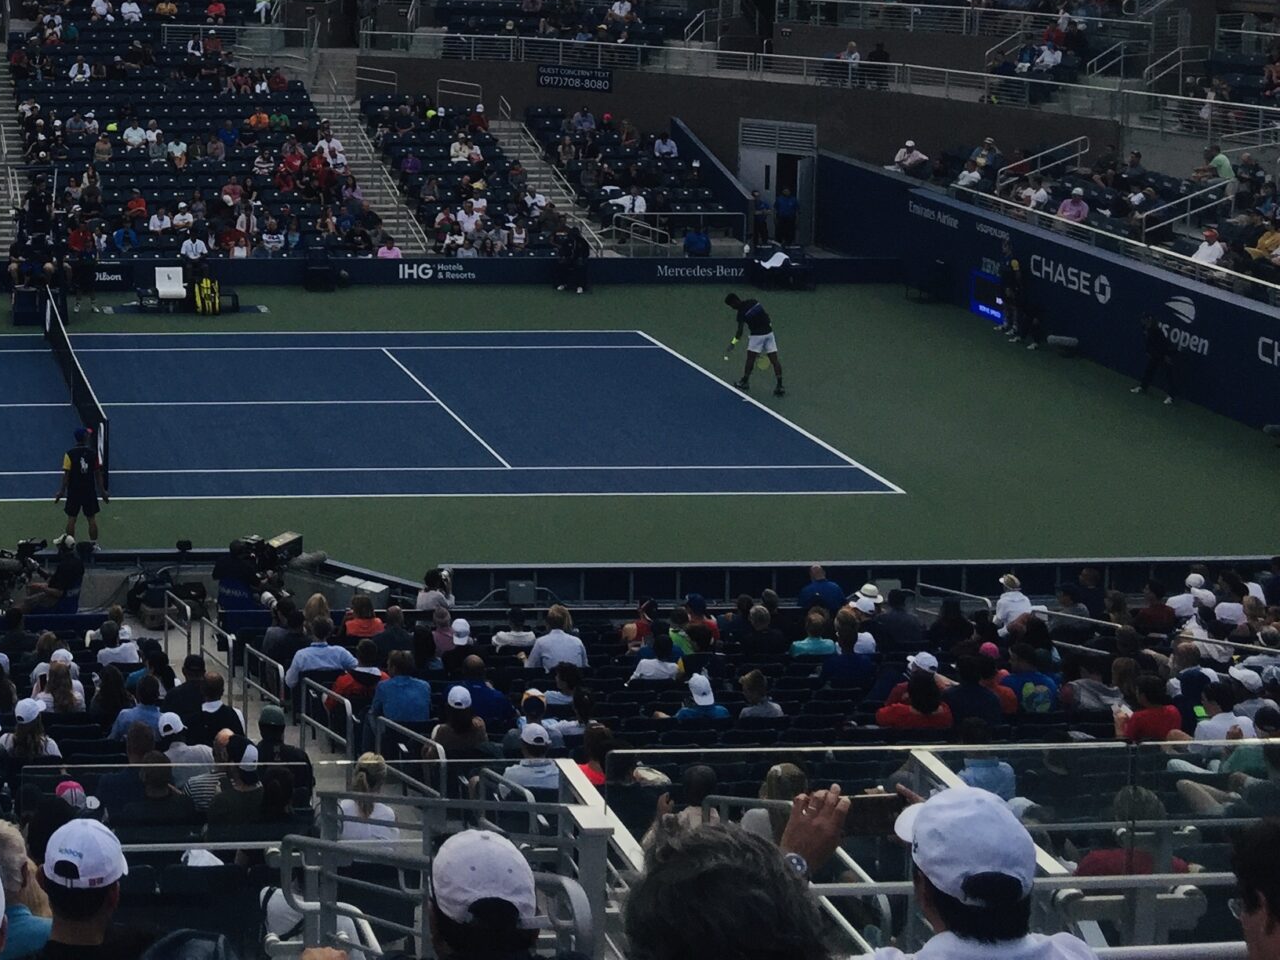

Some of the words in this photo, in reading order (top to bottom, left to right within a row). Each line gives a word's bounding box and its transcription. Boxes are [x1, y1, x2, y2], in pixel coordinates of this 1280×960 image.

[539, 66, 559, 75] GUEST
[398, 263, 434, 280] IHG
[437, 263, 464, 271] Hotels
[657, 264, 745, 277] Mercedes-Benz
[445, 271, 476, 279] Resorts
[1030, 253, 1092, 296] CHASE
[1158, 321, 1170, 339] s
[1170, 326, 1210, 356] open
